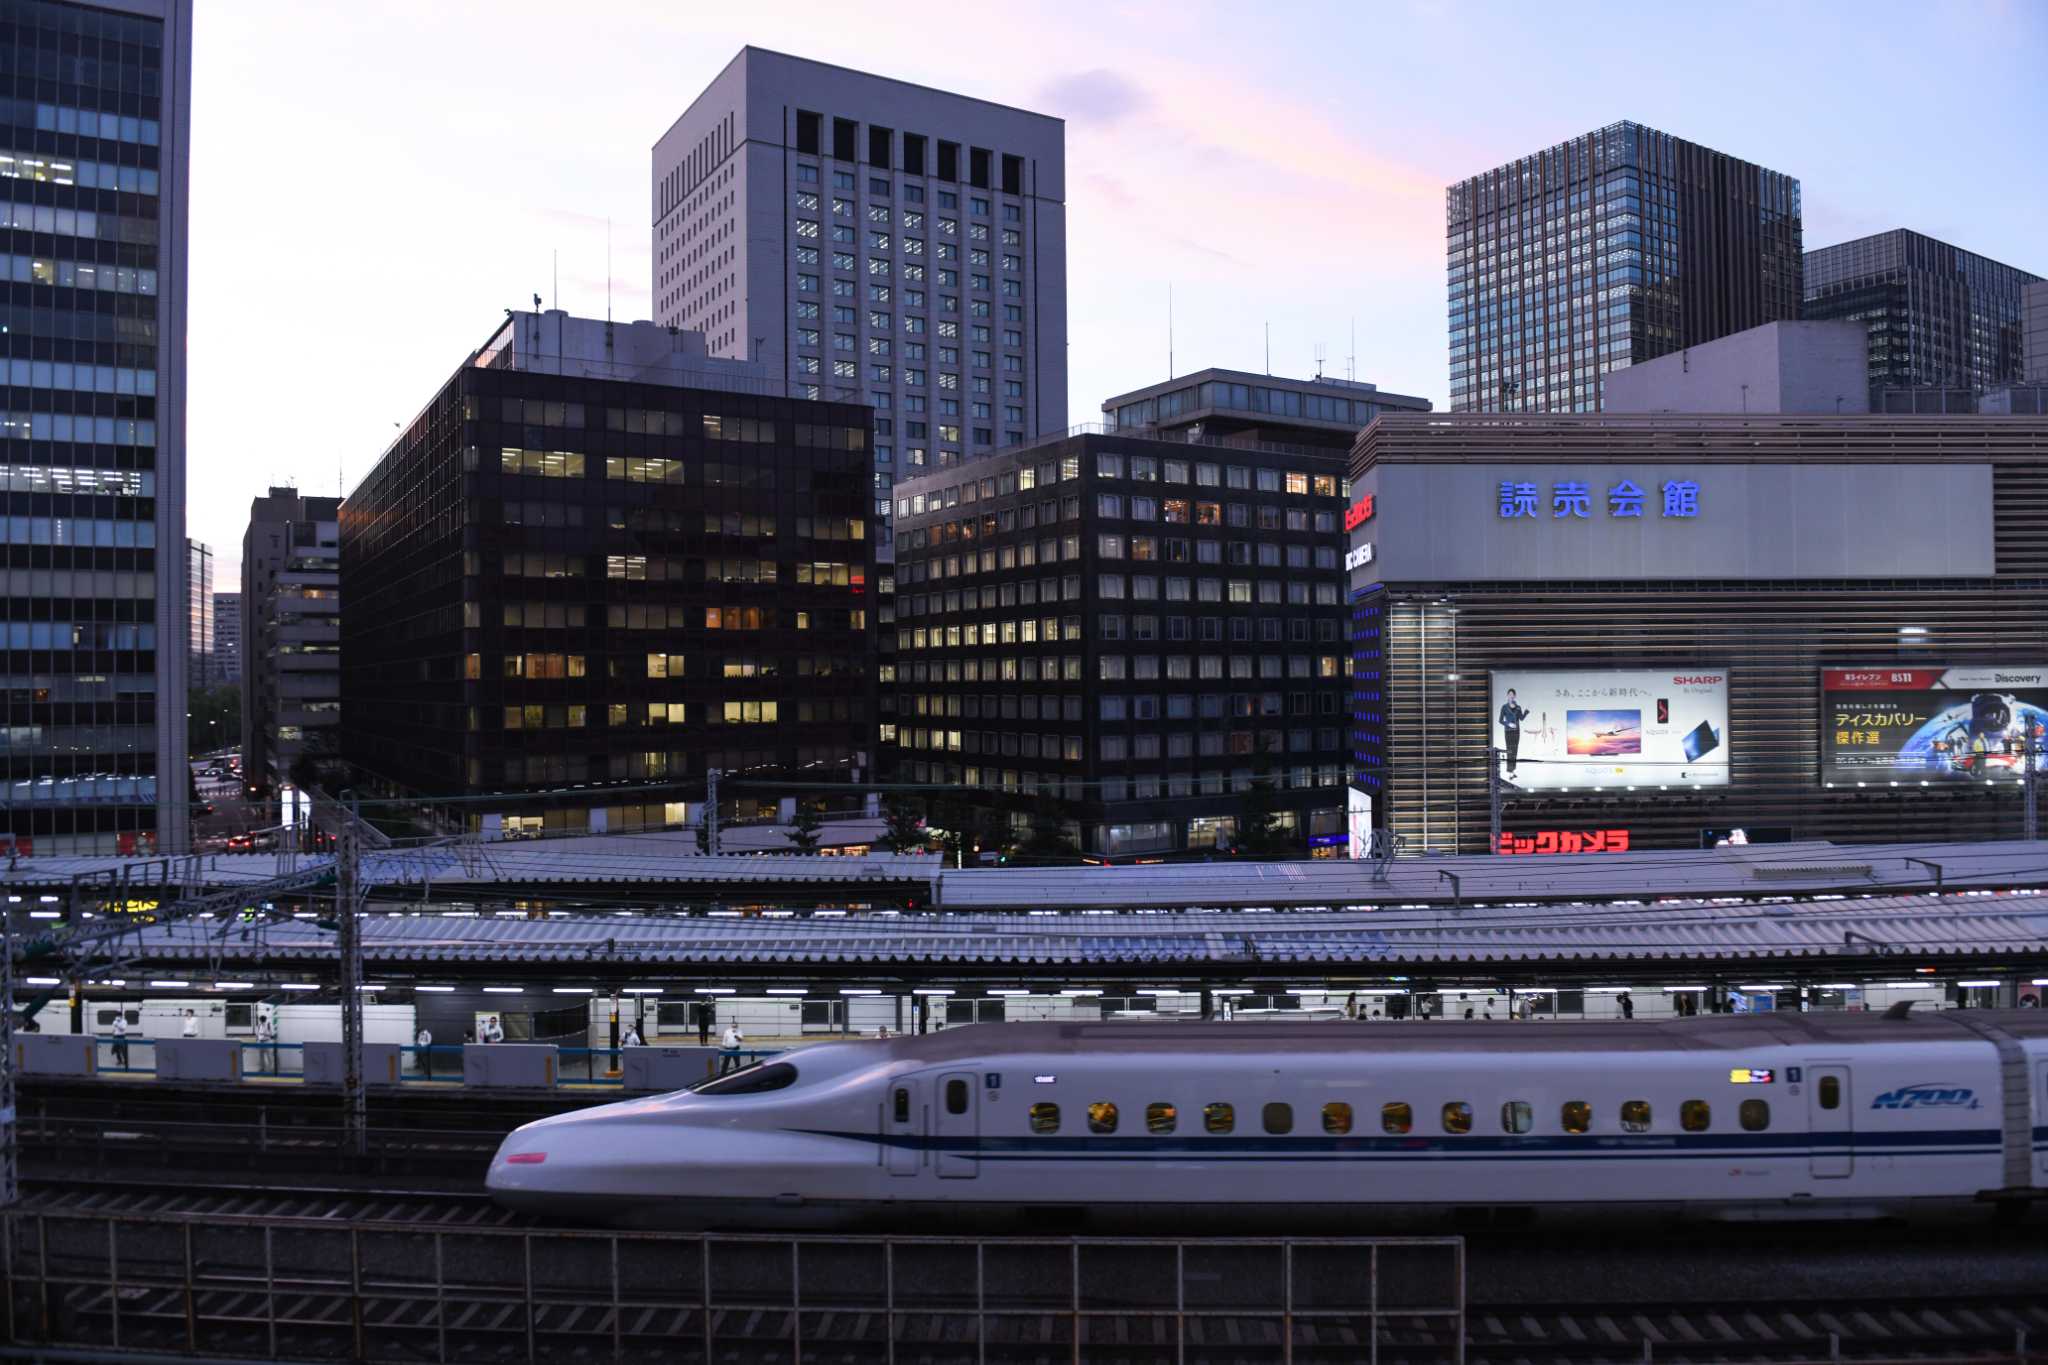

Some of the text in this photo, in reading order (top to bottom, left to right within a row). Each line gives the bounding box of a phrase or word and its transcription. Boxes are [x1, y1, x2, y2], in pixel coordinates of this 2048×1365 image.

[1500, 480, 1700, 518] 読売会館
[1673, 675, 1722, 685] SHARP
[1891, 672, 1912, 683] BS11
[1995, 673, 2041, 684] Discovery
[1835, 713, 1928, 727] ディスカバリー
[1836, 731, 1881, 745] 傑作選
